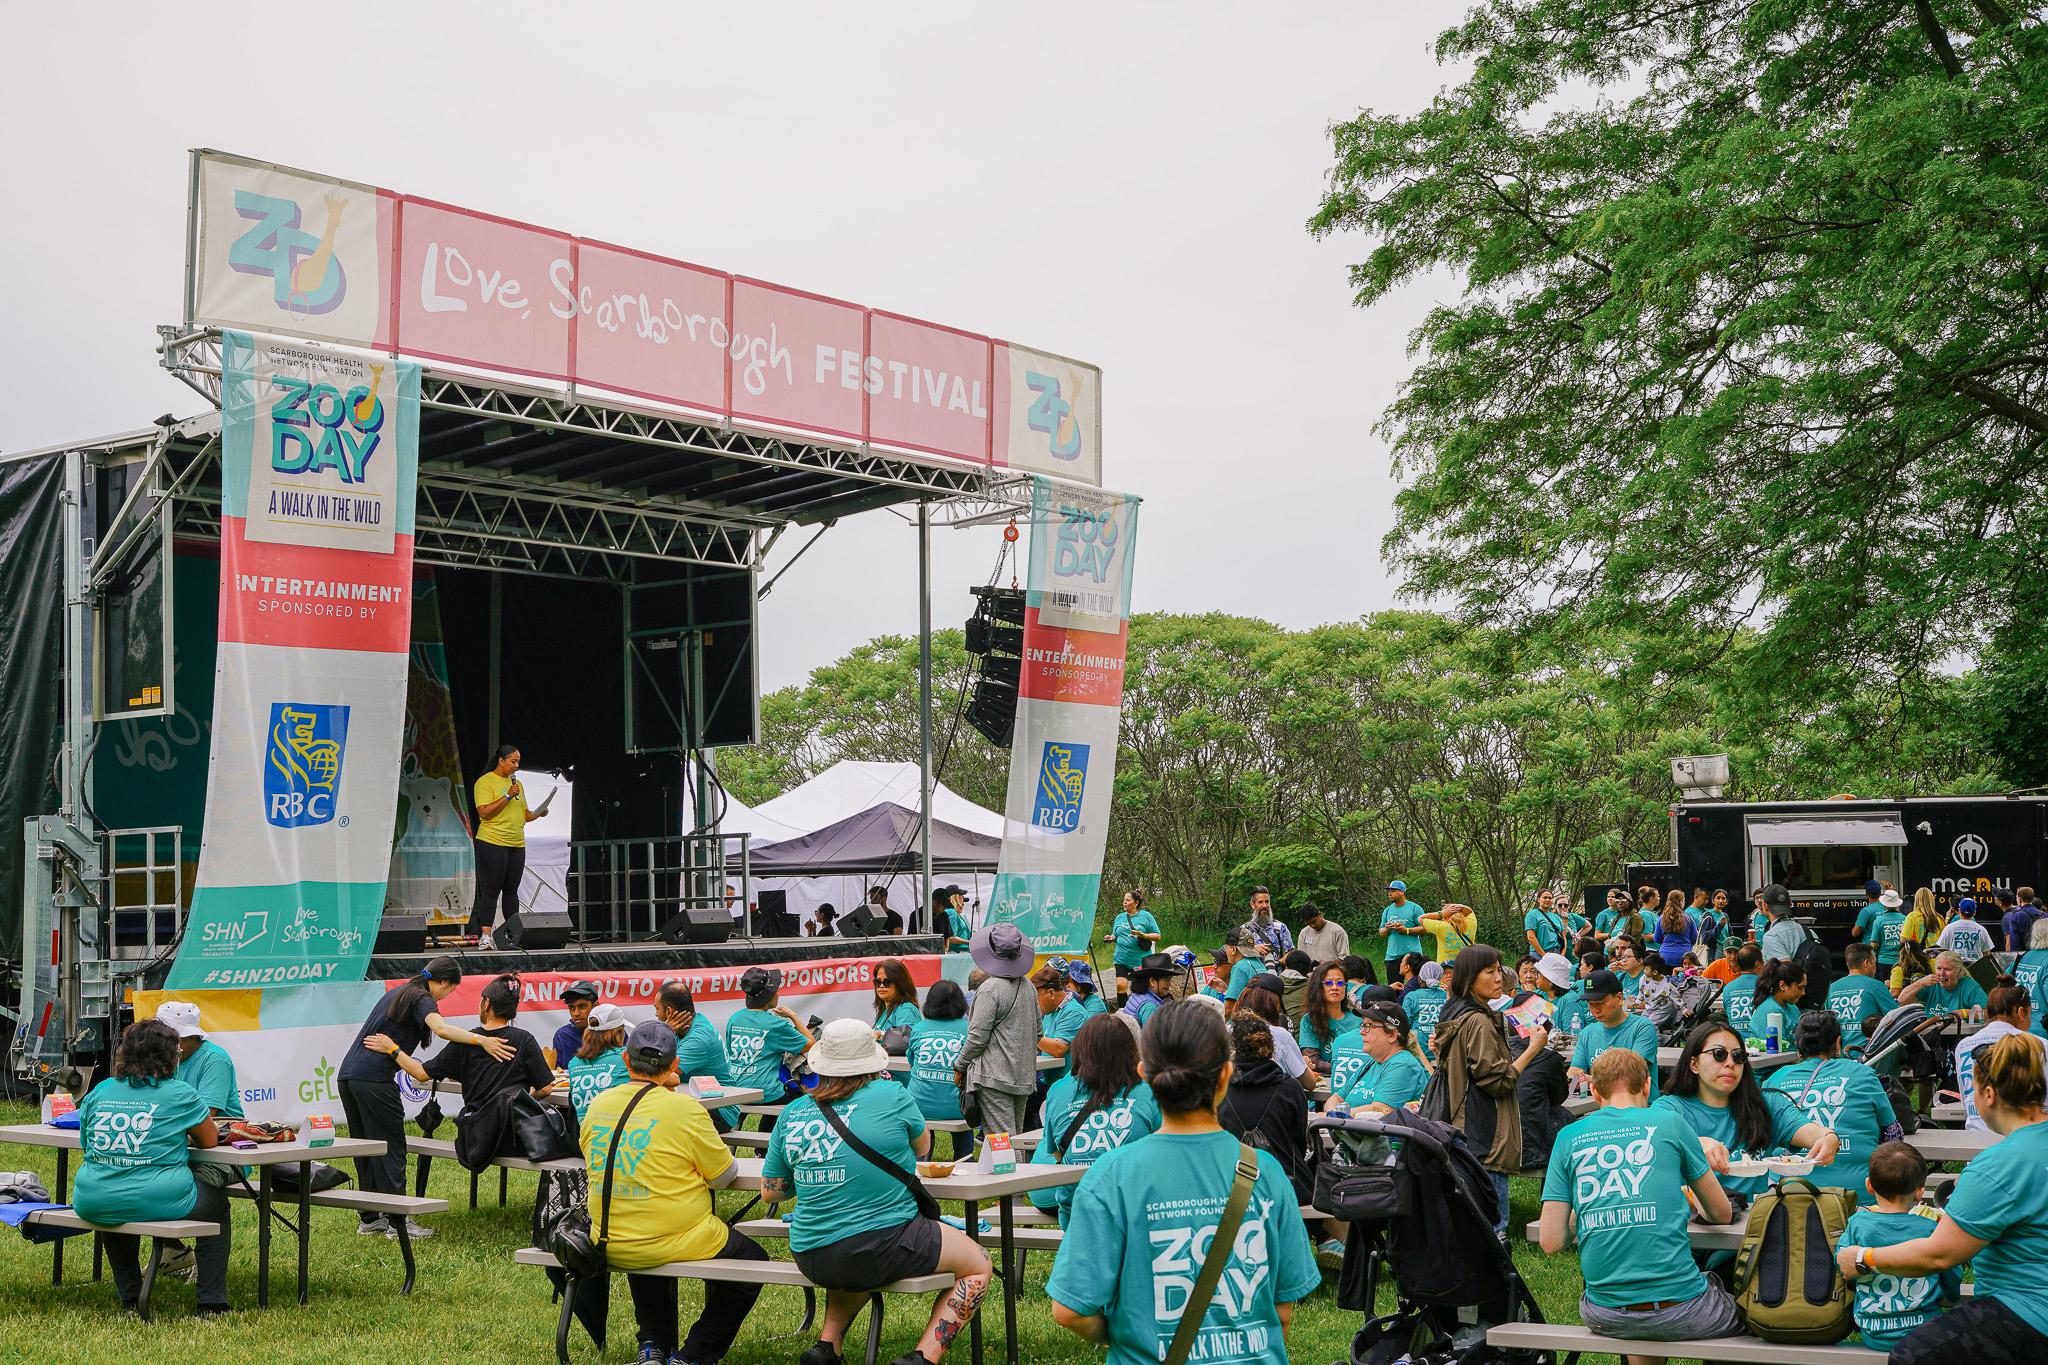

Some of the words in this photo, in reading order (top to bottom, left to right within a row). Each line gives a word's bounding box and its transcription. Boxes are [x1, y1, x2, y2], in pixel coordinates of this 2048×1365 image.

[421, 242, 530, 321] Love,
[549, 259, 794, 396] Scarborough
[815, 344, 988, 418] FESTIVAL
[270, 346, 331, 363] SCARBOROUGH
[333, 357, 363, 368] HEALTH
[270, 358, 309, 370] NETWORK
[312, 363, 363, 377] FOUNDATION
[271, 373, 385, 434] ZOO
[271, 421, 381, 484] DAY
[269, 490, 277, 514] A
[281, 491, 314, 518] WALK
[317, 494, 328, 520] IN
[332, 496, 351, 523] THE
[354, 499, 381, 525] WILD
[1057, 505, 1119, 548] ZOO
[1053, 541, 1116, 584] DAY
[257, 600, 353, 618] SPONSORED
[360, 607, 378, 620] BY
[1058, 590, 1077, 609] WALK
[1079, 592, 1085, 610] IN
[1086, 592, 1097, 612] THE
[1099, 593, 1114, 614] WILD
[1026, 648, 1123, 671] ENTERTAINMENT
[1042, 667, 1095, 681] SPONSORED
[1099, 673, 1109, 682] BY
[271, 791, 330, 819] RBC
[1038, 807, 1077, 829] RBC
[1813, 900, 1830, 908] and
[1972, 895, 1993, 904] tru
[201, 922, 247, 941] SHN
[1954, 930, 1980, 941] ZOO
[1954, 940, 1977, 950] DAY
[203, 963, 339, 985] #SHNZOODAY
[522, 980, 568, 1003] ANK
[591, 979, 620, 999] OU
[628, 978, 654, 998] TO
[663, 975, 703, 993] UR
[710, 974, 743, 993] EVE
[779, 965, 870, 988] SPONSORS
[1731, 996, 1754, 1008] ZO
[1830, 994, 1862, 1009] ZOO
[1419, 1013, 1440, 1024] DA
[1731, 1006, 1754, 1020] DA
[731, 1034, 765, 1050] ZOO
[919, 1037, 962, 1052] ZOO
[918, 1050, 959, 1067] DAY
[1335, 1057, 1363, 1072] ZO
[298, 1067, 339, 1103] GFL
[571, 1072, 613, 1093] ZOO
[244, 1088, 276, 1102] SEMI
[94, 1111, 153, 1132] ZOO
[1807, 1106, 1845, 1130] AY
[93, 1131, 151, 1154] DAY
[1071, 1129, 1131, 1154] DAY
[1600, 1131, 1641, 1141] FOUNDATION
[591, 1148, 646, 1176] DAY
[785, 1137, 844, 1166] DAY
[1572, 1139, 1655, 1176] ZOO
[815, 1169, 827, 1183] THE
[828, 1168, 846, 1183] WILD
[1576, 1165, 1654, 1205] DAY
[1146, 1197, 1217, 1212] SCARBOROUGH
[1147, 1208, 1193, 1221] NETWORK
[1195, 1206, 1256, 1216] FOUNN
[1585, 1210, 1606, 1230] WALK
[1606, 1210, 1616, 1226] IN
[1616, 1208, 1633, 1225] THE
[1633, 1206, 1657, 1222] WILD
[1153, 1265, 1270, 1321] DAY
[1856, 1274, 1930, 1302] OO
[1870, 1319, 1880, 1331] IN
[1883, 1318, 1898, 1330] THE
[1900, 1315, 1924, 1328] WILD
[1220, 1331, 1245, 1356] THE
[1247, 1326, 1269, 1353] WILD
